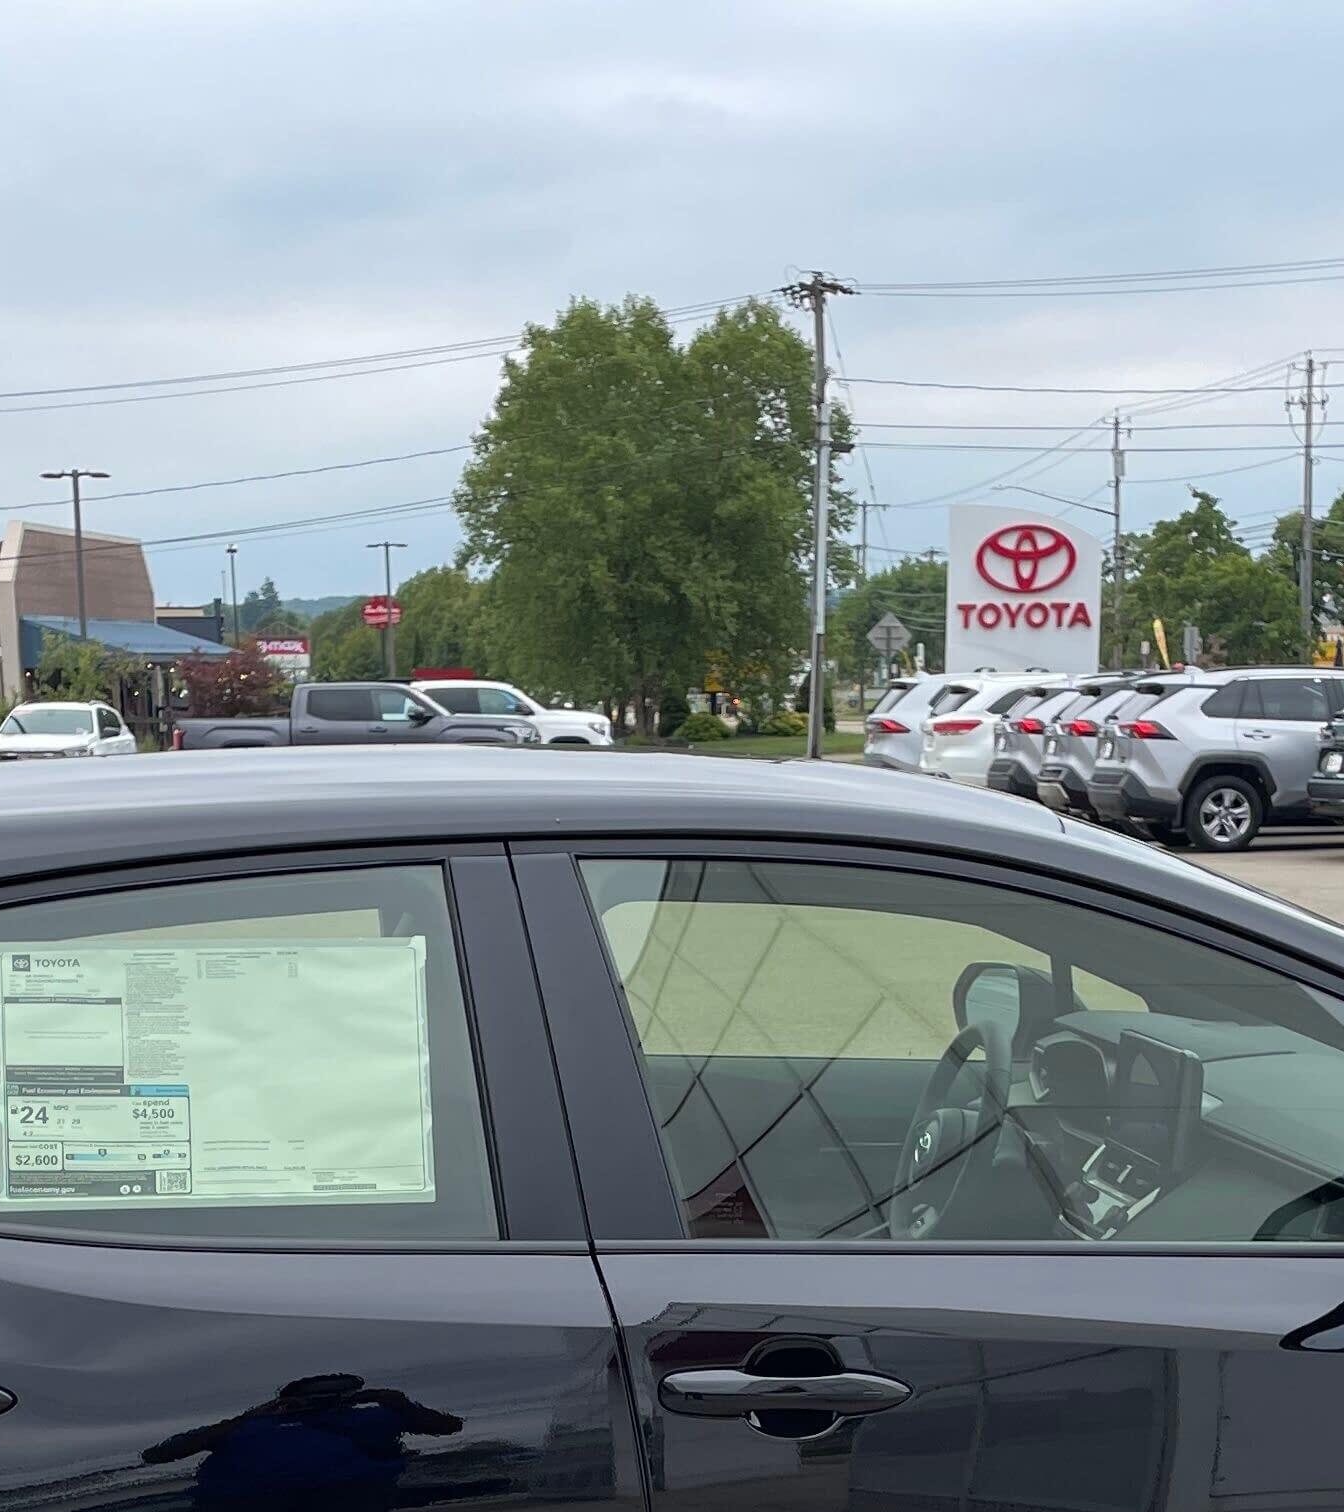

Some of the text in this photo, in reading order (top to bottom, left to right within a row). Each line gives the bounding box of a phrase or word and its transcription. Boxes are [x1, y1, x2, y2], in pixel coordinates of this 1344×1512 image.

[957, 602, 1092, 629] TOYOTA
[35, 958, 80, 968] TOYOTA
[20, 1106, 49, 1124] 24
[132, 1108, 175, 1120] $4,500
[16, 1154, 58, 1167] $2,600
